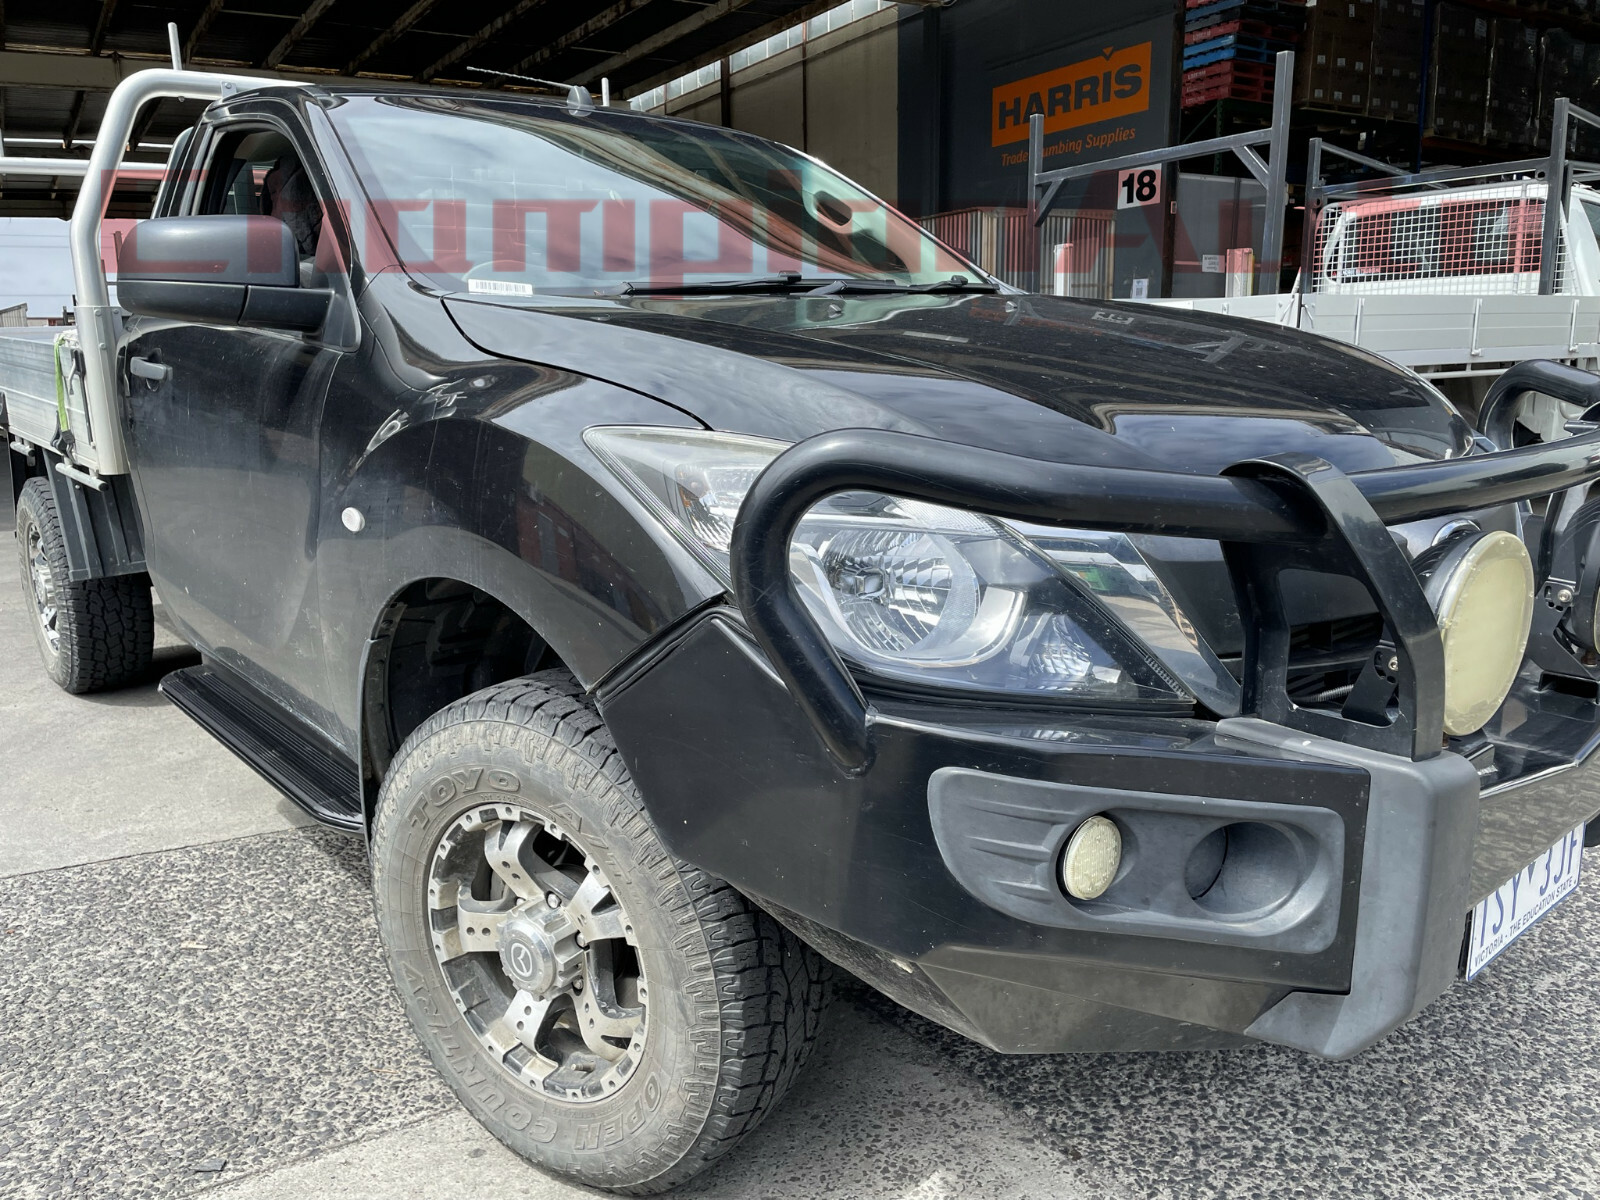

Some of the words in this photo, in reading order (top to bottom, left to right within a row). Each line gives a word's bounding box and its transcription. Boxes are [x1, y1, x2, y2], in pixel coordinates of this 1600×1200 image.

[998, 63, 1143, 130] HARRIS
[1001, 150, 1029, 167] Trade
[1042, 138, 1083, 158] umbing
[1085, 126, 1136, 149] Supplies
[1121, 169, 1157, 204] 18
[405, 765, 521, 831] TOYO
[1474, 933, 1504, 967] VICTORIA
[1509, 920, 1522, 936] THE
[1522, 889, 1556, 925] EDUCATION
[1556, 877, 1573, 898] STATE
[573, 1072, 661, 1151] OPEN
